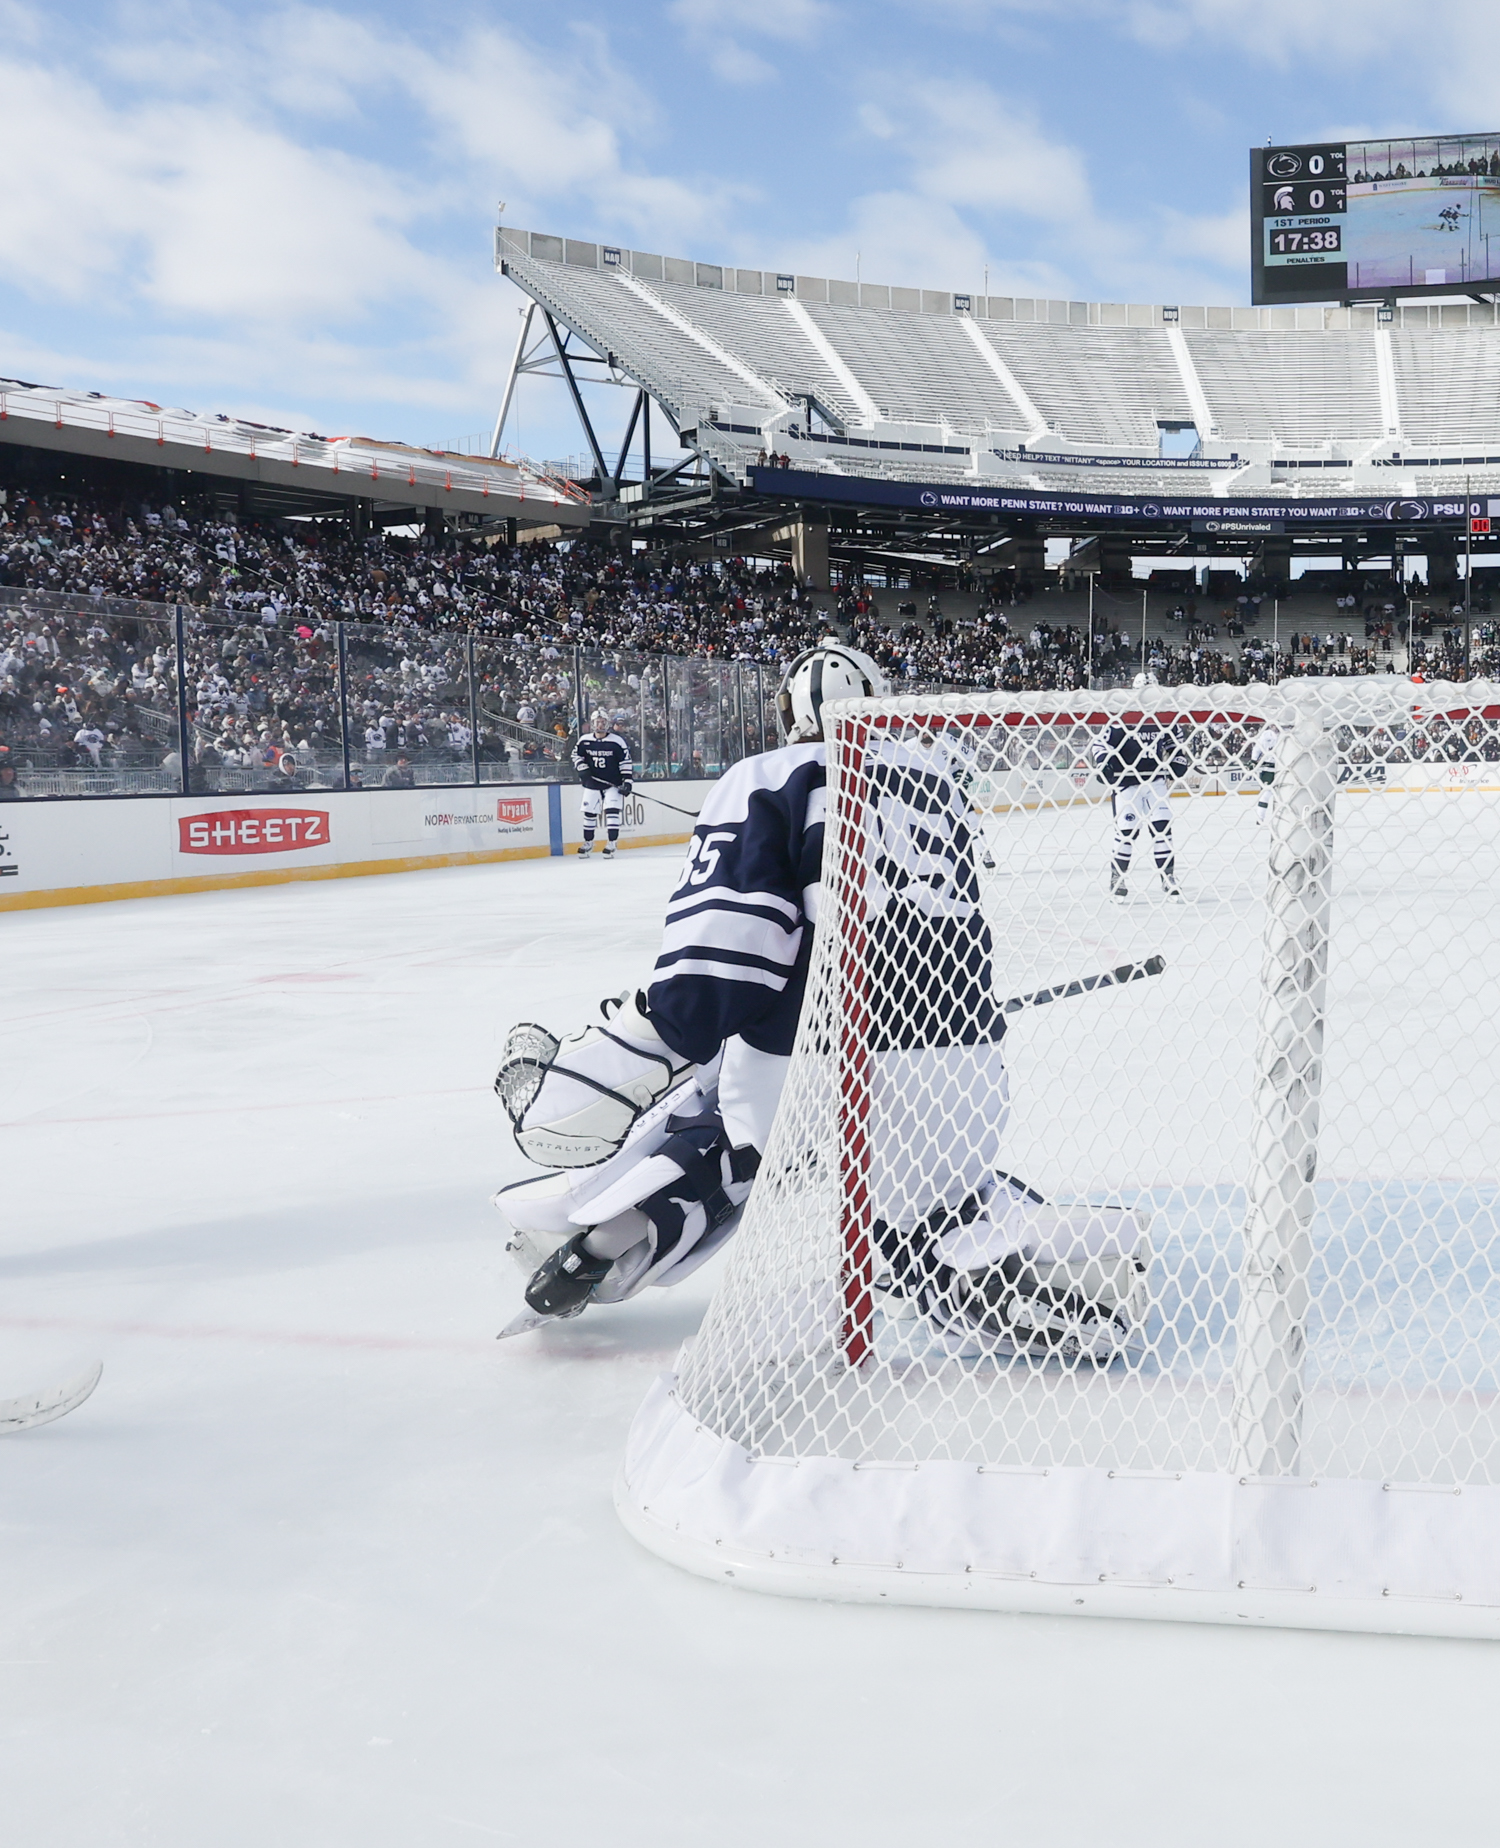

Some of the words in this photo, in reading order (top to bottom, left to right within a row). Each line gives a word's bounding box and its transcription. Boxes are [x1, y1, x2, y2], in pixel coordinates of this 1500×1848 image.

[1308, 155, 1325, 175] 0
[1336, 162, 1344, 173] 1
[1309, 189, 1325, 209] 0
[1336, 199, 1344, 210] 1
[1274, 218, 1294, 227] 1ST
[1298, 217, 1331, 226] PERIOD
[1274, 230, 1338, 252] 17:38
[605, 252, 620, 263] NAU
[1286, 256, 1325, 264] PENALTIES
[1379, 311, 1392, 320] NEU
[1022, 452, 1043, 460] HELP?
[1044, 454, 1061, 462] TEXT
[941, 494, 969, 506] WANT
[971, 496, 999, 508] MORE
[1001, 498, 1027, 509] PENN
[1028, 500, 1063, 512] STATE?
[1064, 501, 1084, 513] YOU
[1085, 502, 1112, 514] WANT
[1432, 503, 1464, 516] PSU
[1469, 503, 1481, 516] 0
[1162, 506, 1191, 516] WANT
[1192, 506, 1222, 517] MORE
[1222, 507, 1250, 517] PENN
[1250, 507, 1287, 517] STATE?
[1287, 507, 1307, 517] YOU
[1308, 507, 1337, 517] WANT
[1220, 522, 1271, 532] #PSUnrivaled
[592, 757, 606, 769] 72
[501, 802, 529, 819] bryant
[424, 813, 494, 826] NOPAYBRYANT.COM
[189, 816, 321, 848] SHEETZ
